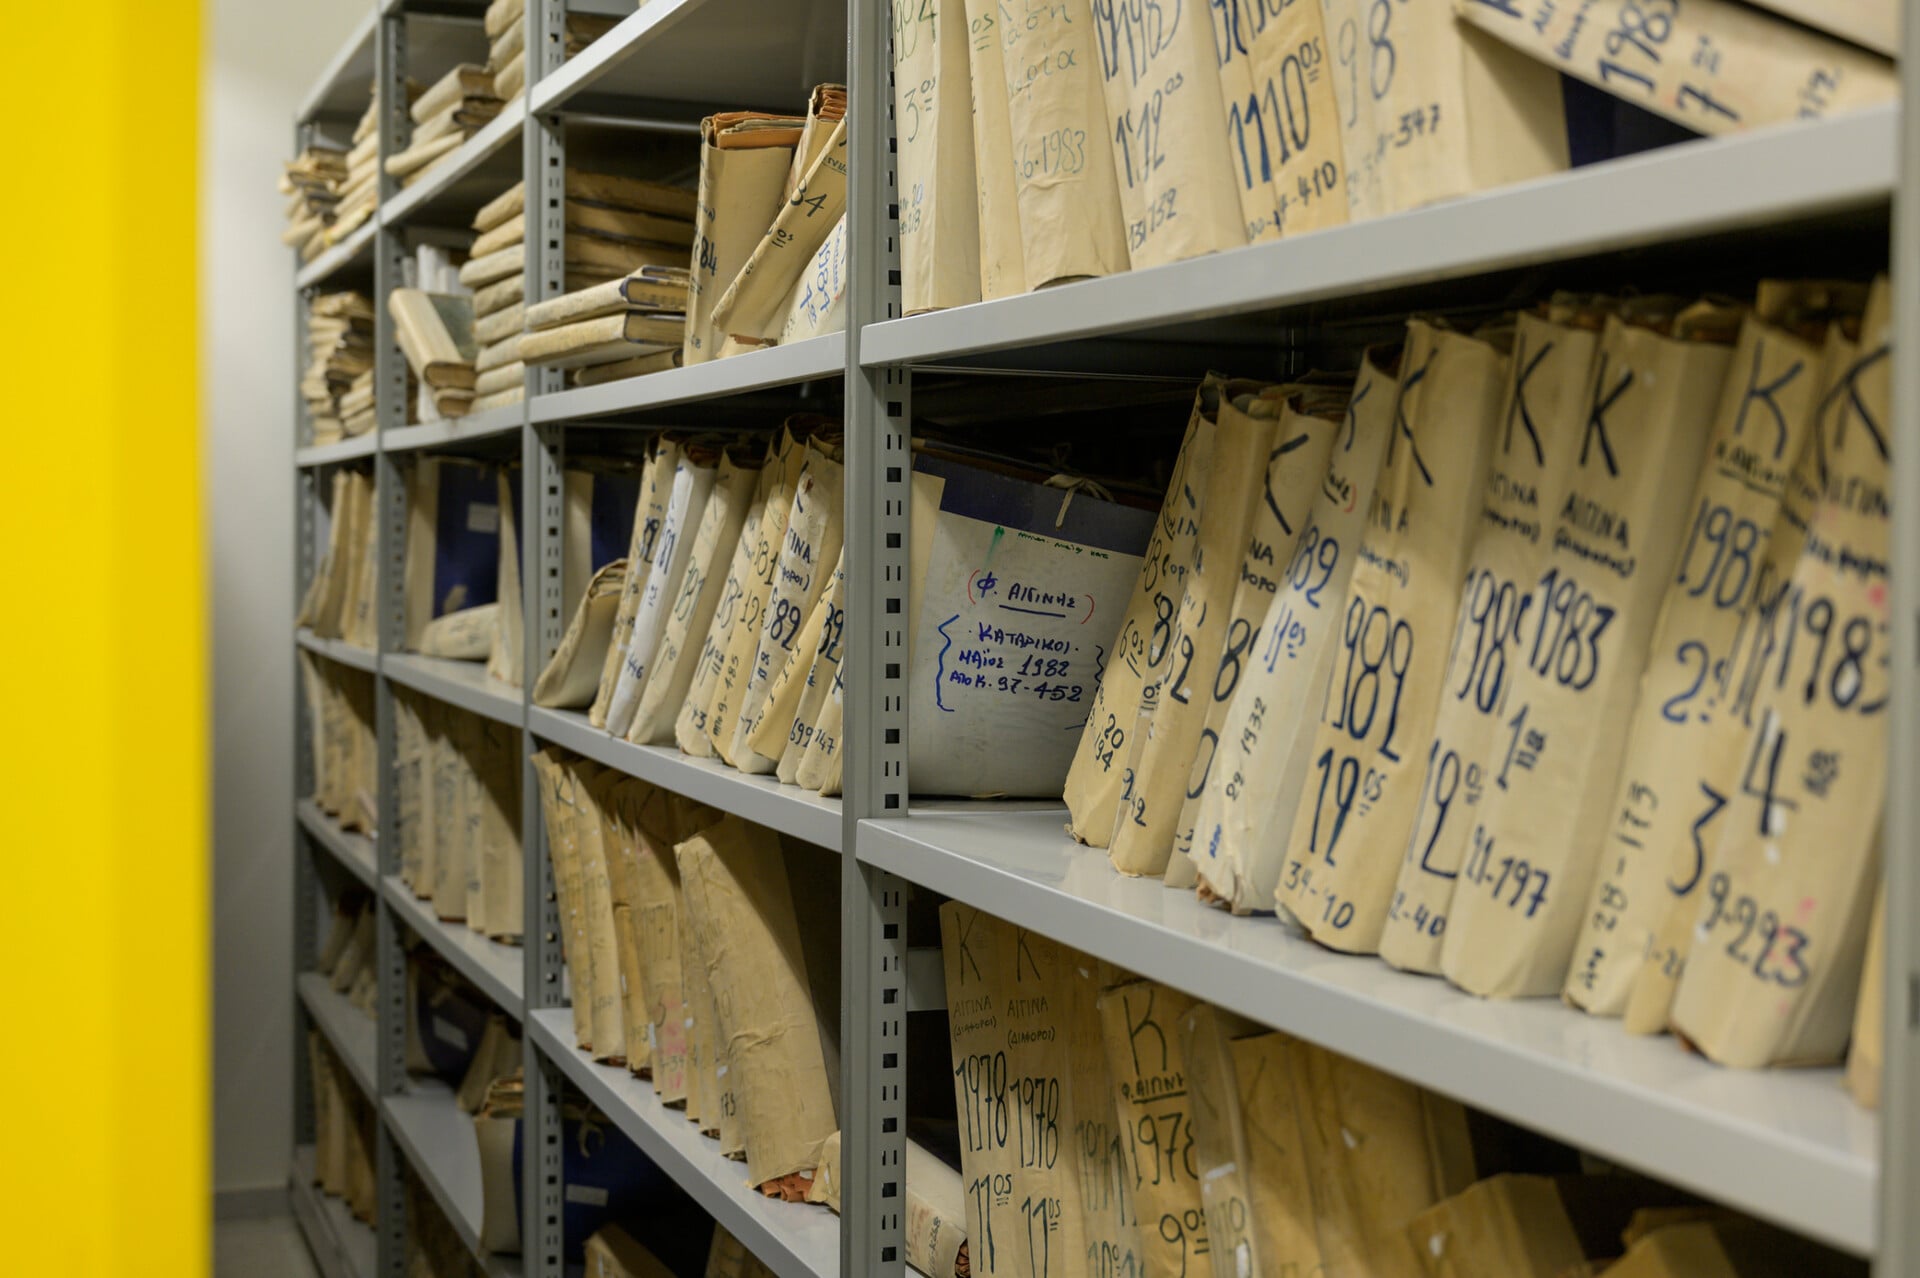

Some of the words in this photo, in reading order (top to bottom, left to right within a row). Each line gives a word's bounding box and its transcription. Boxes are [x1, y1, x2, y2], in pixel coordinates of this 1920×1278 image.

[1016, 654, 1070, 678] 1982
[955, 1051, 1009, 1153] 1978
[1009, 1077, 1061, 1170] 1978
